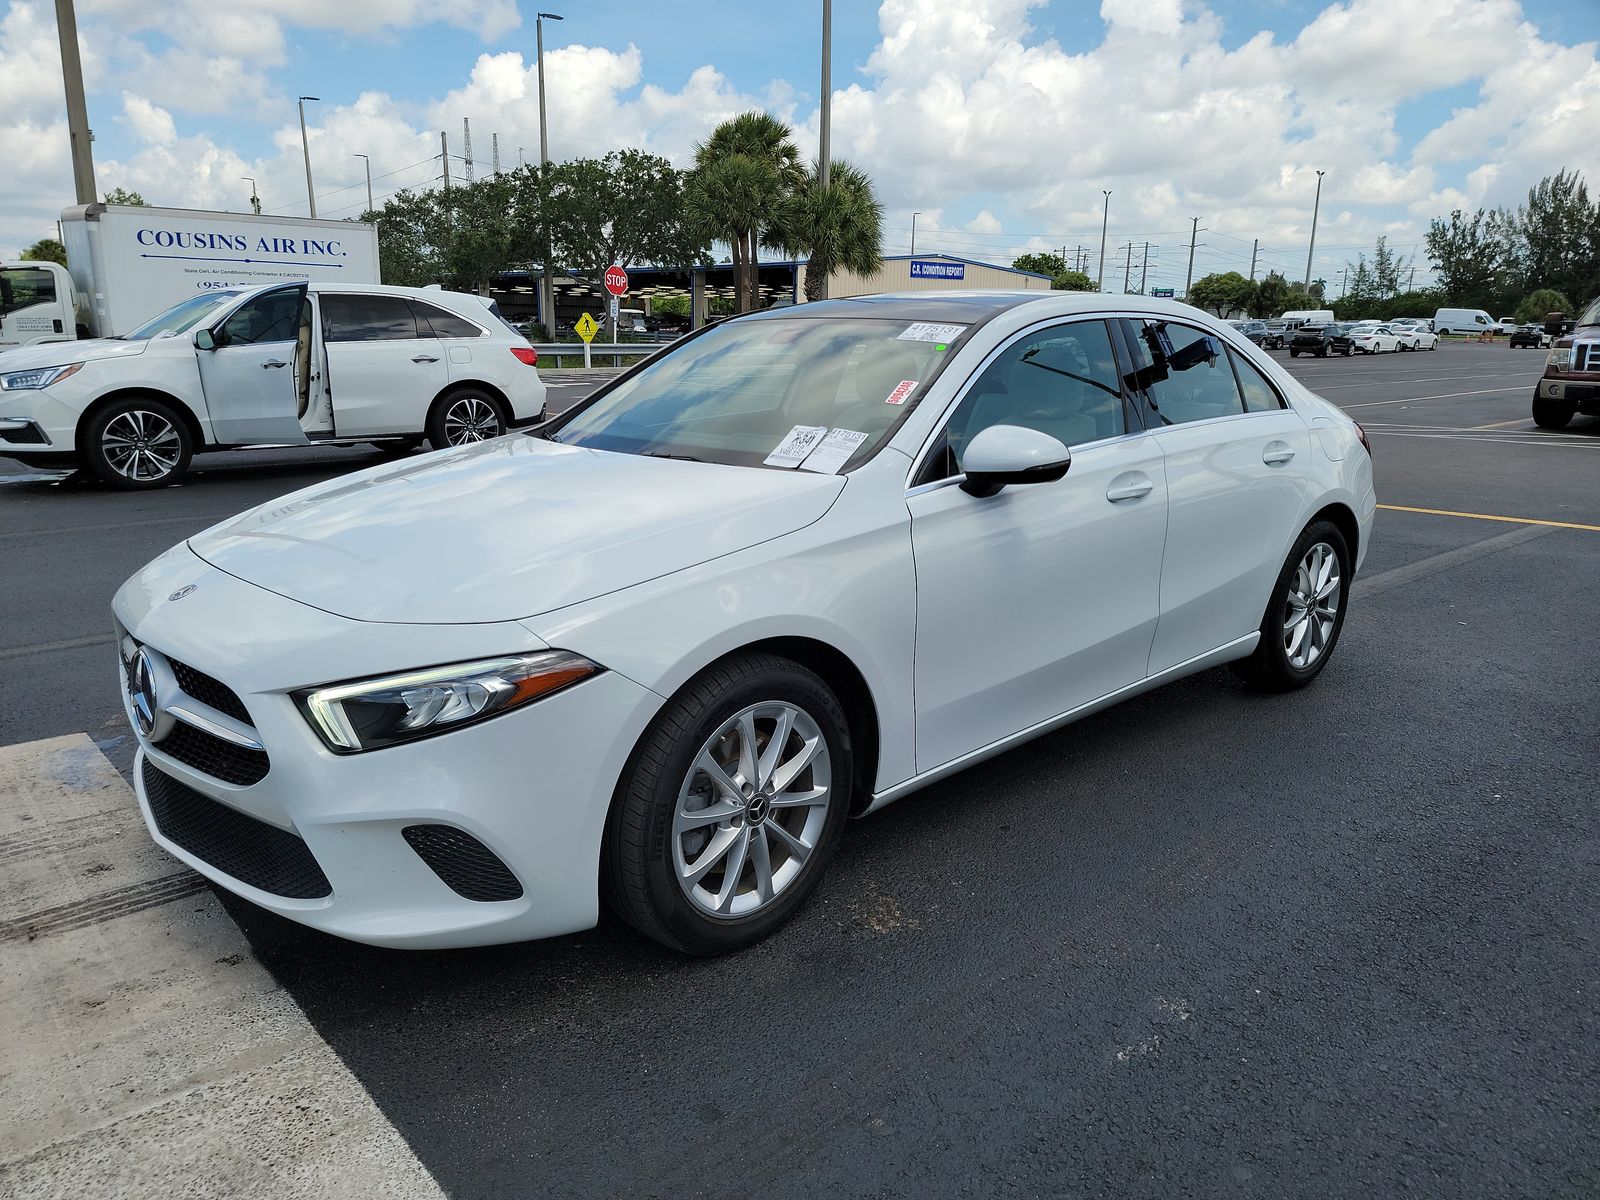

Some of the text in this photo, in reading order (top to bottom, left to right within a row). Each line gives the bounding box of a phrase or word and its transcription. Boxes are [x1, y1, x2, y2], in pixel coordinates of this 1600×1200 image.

[136, 229, 347, 257] COUSINS AIR INC.
[606, 274, 626, 287] STOP
[911, 324, 960, 334] 4175131
